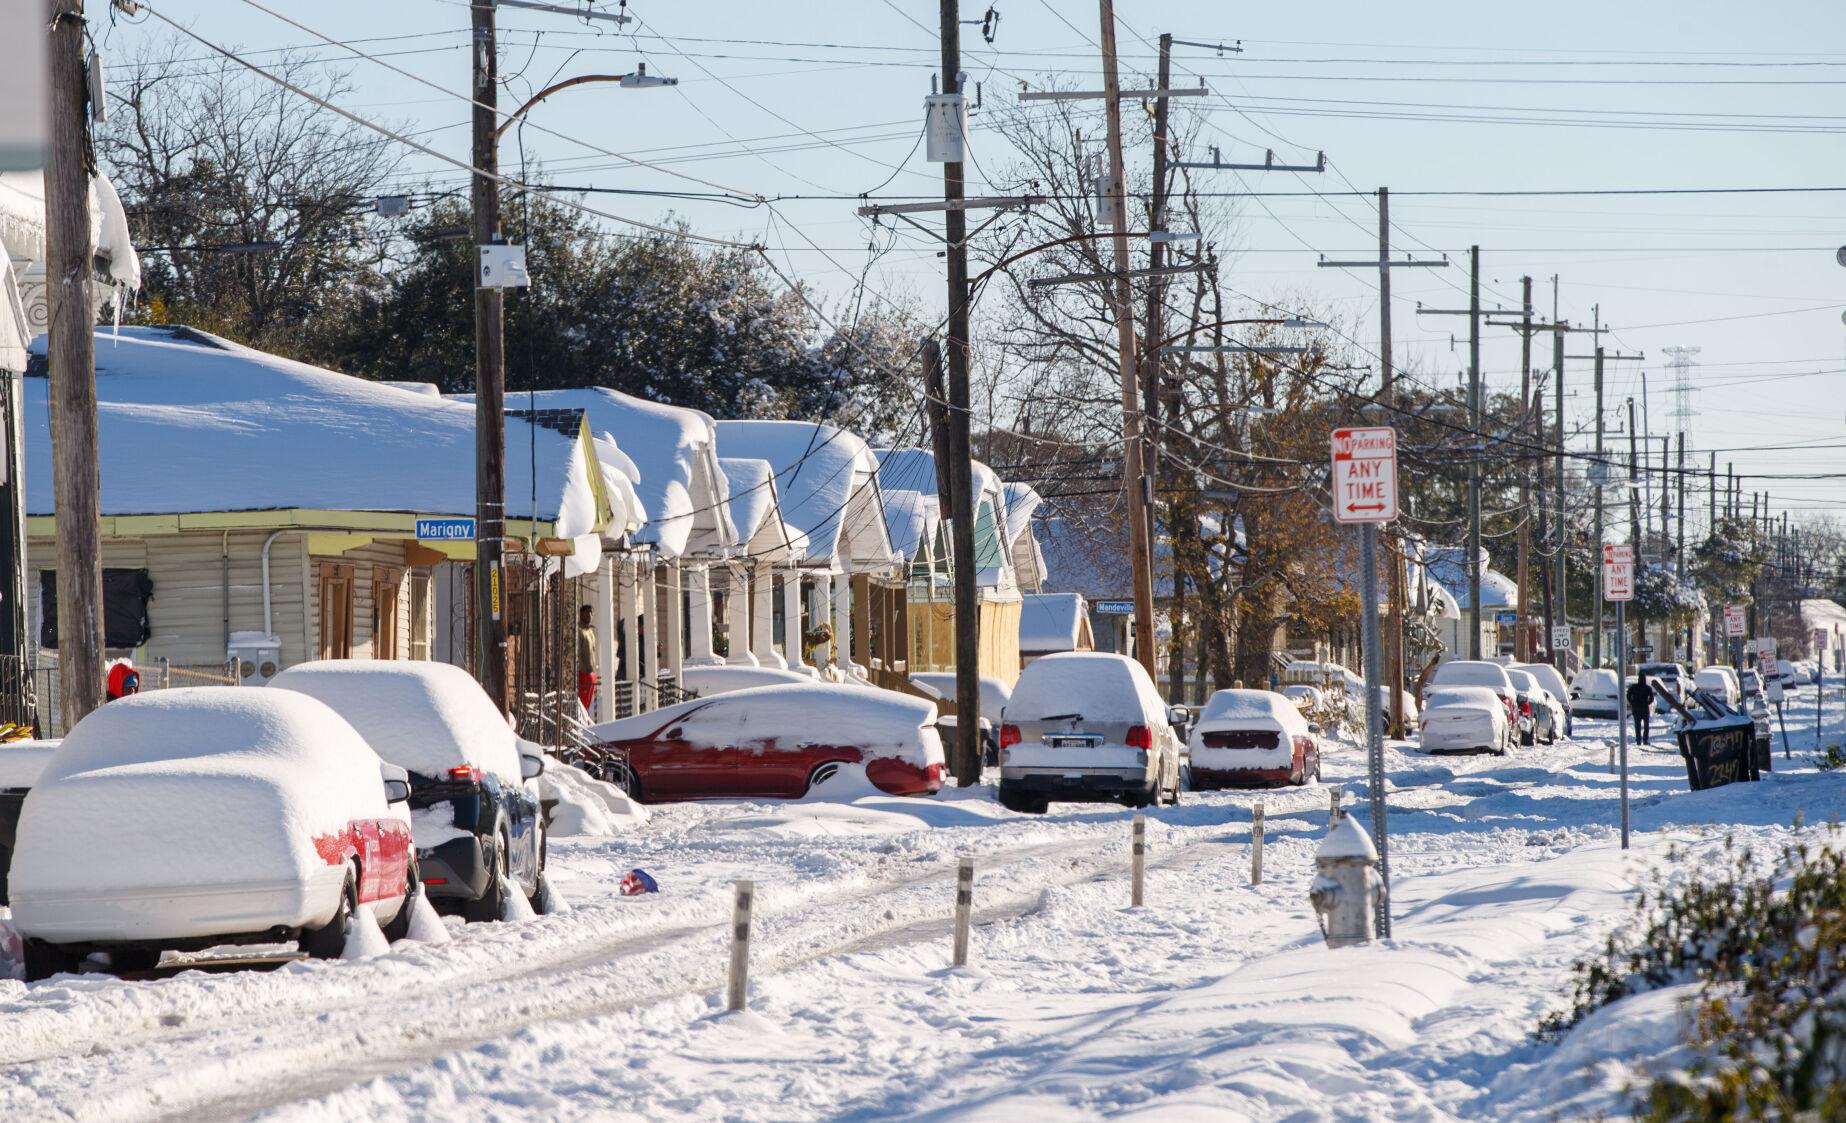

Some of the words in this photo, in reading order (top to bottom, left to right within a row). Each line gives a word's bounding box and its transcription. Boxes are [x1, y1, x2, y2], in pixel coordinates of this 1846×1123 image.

[1352, 438, 1393, 450] PARKING
[1348, 461, 1382, 478] ANY
[1346, 482, 1385, 499] TIME
[420, 522, 470, 539] Marigny
[491, 569, 499, 612] 21025
[1610, 577, 1628, 587] TIME
[1554, 639, 1570, 648] 30
